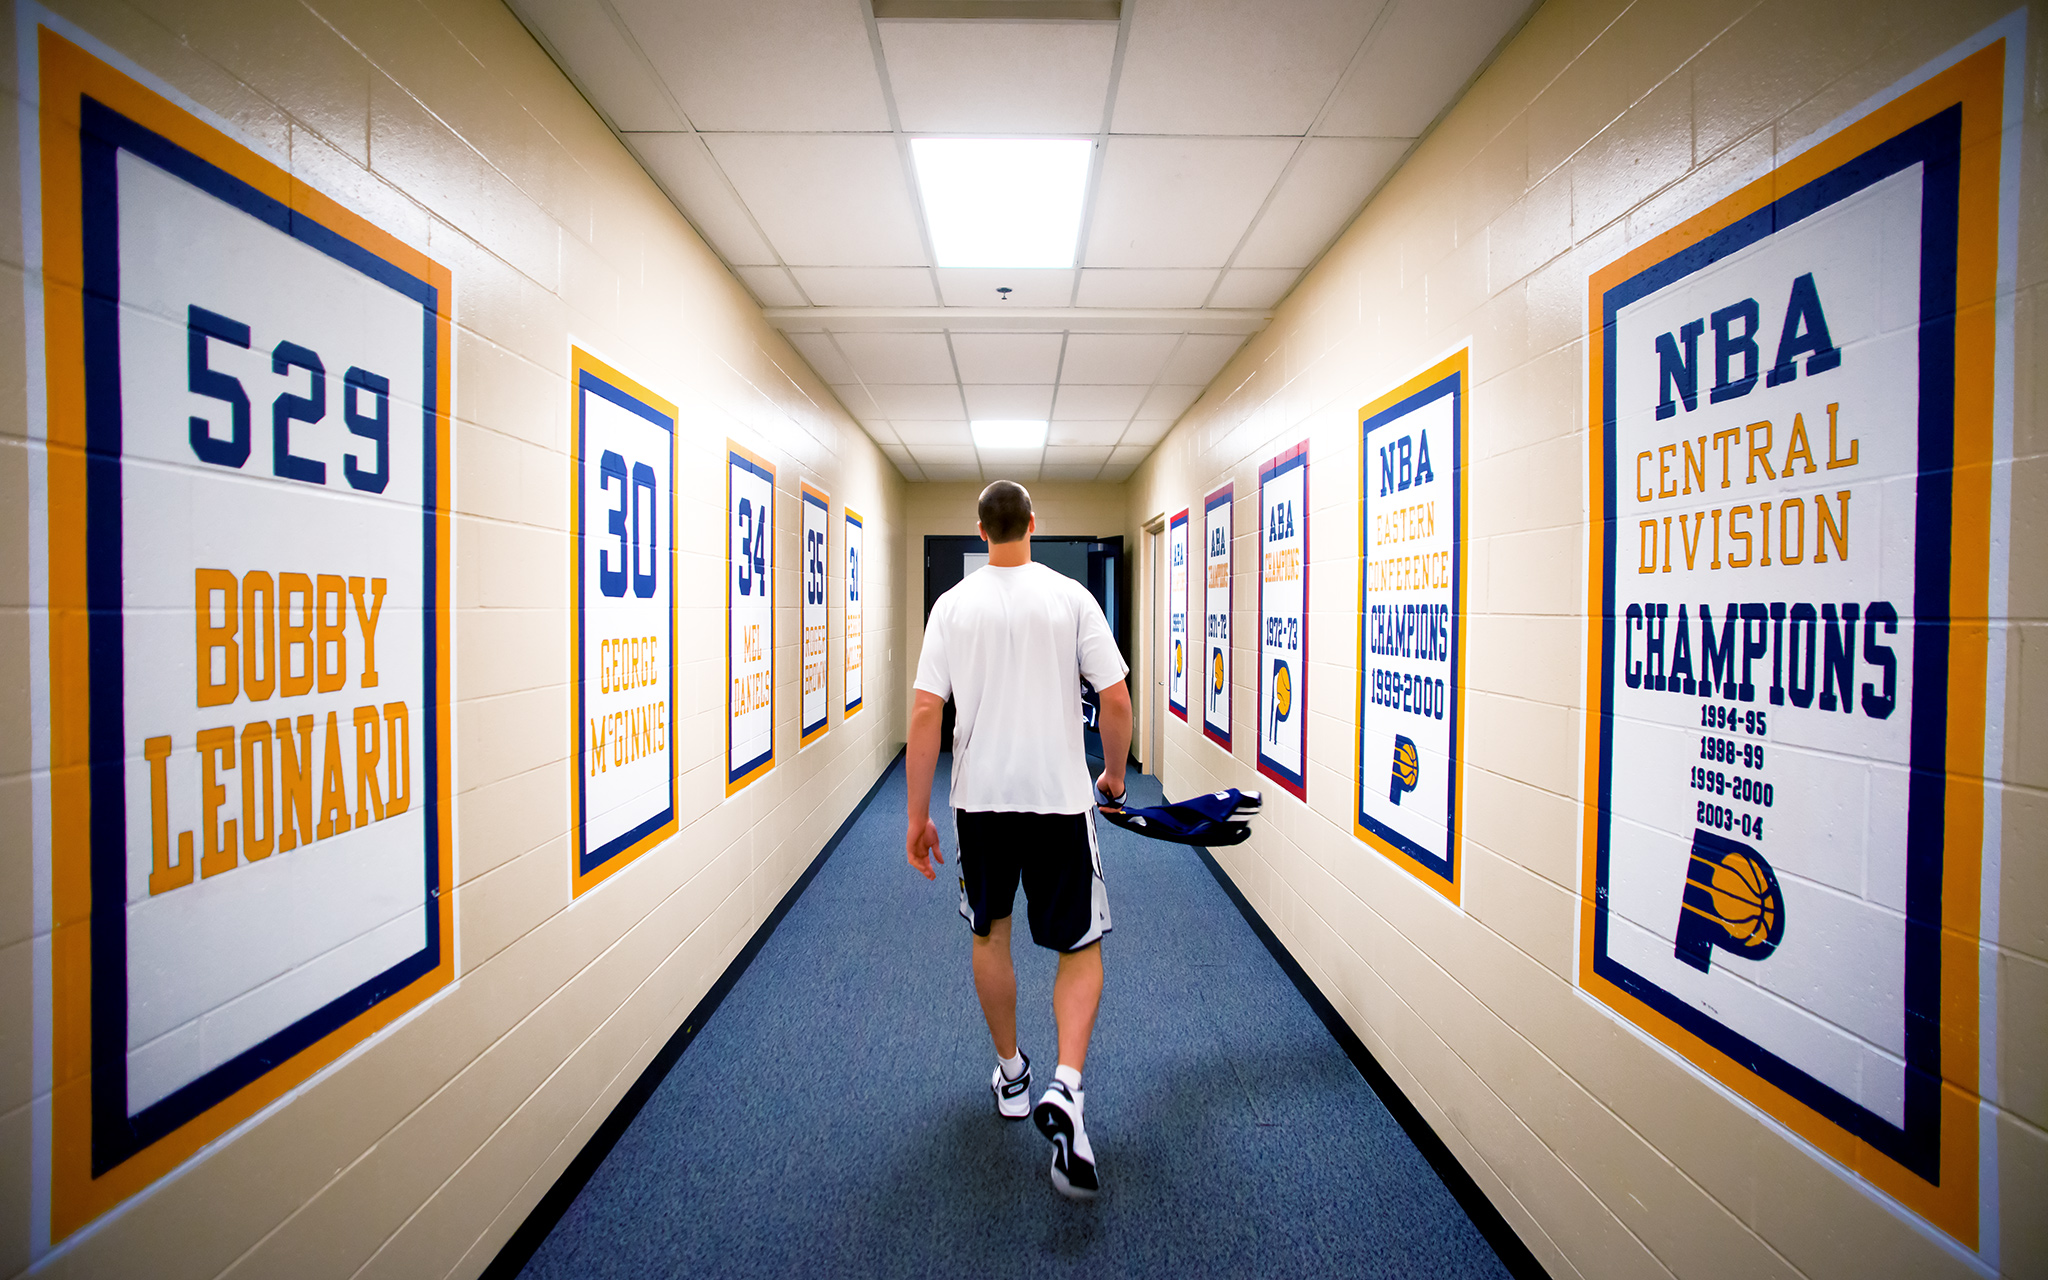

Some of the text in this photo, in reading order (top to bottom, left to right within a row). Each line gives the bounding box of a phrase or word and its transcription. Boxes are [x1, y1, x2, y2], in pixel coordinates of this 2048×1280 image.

[1654, 271, 1842, 422] NBA
[188, 304, 390, 494] 529
[1380, 428, 1434, 498] NBA
[1636, 401, 1859, 503] CENTRAL
[600, 449, 657, 599] 30
[738, 497, 766, 597] 34
[1210, 526, 1226, 557] ABA
[1269, 500, 1295, 543] ABA
[1376, 501, 1435, 546] EASTERN
[1638, 490, 1852, 575] DIVISION
[807, 529, 824, 605] 35
[849, 547, 859, 601] 31
[1368, 550, 1449, 592] CONFERENCE
[195, 567, 387, 709] BOBBY
[743, 624, 762, 663] MEL
[1266, 616, 1298, 651] 1972-73
[1370, 603, 1449, 662] CHAMPIONS
[1624, 600, 1899, 721] CHAMPIONS
[601, 635, 658, 695] GEORGE
[734, 670, 770, 718] DANIELS
[1371, 667, 1444, 721] 1999-2000
[1701, 704, 1767, 736] 1994-95
[1700, 736, 1765, 770] 1998-99
[144, 701, 410, 897] LEONARD
[1690, 765, 1774, 808] 1999-2000
[1696, 800, 1763, 841] 2003-04
